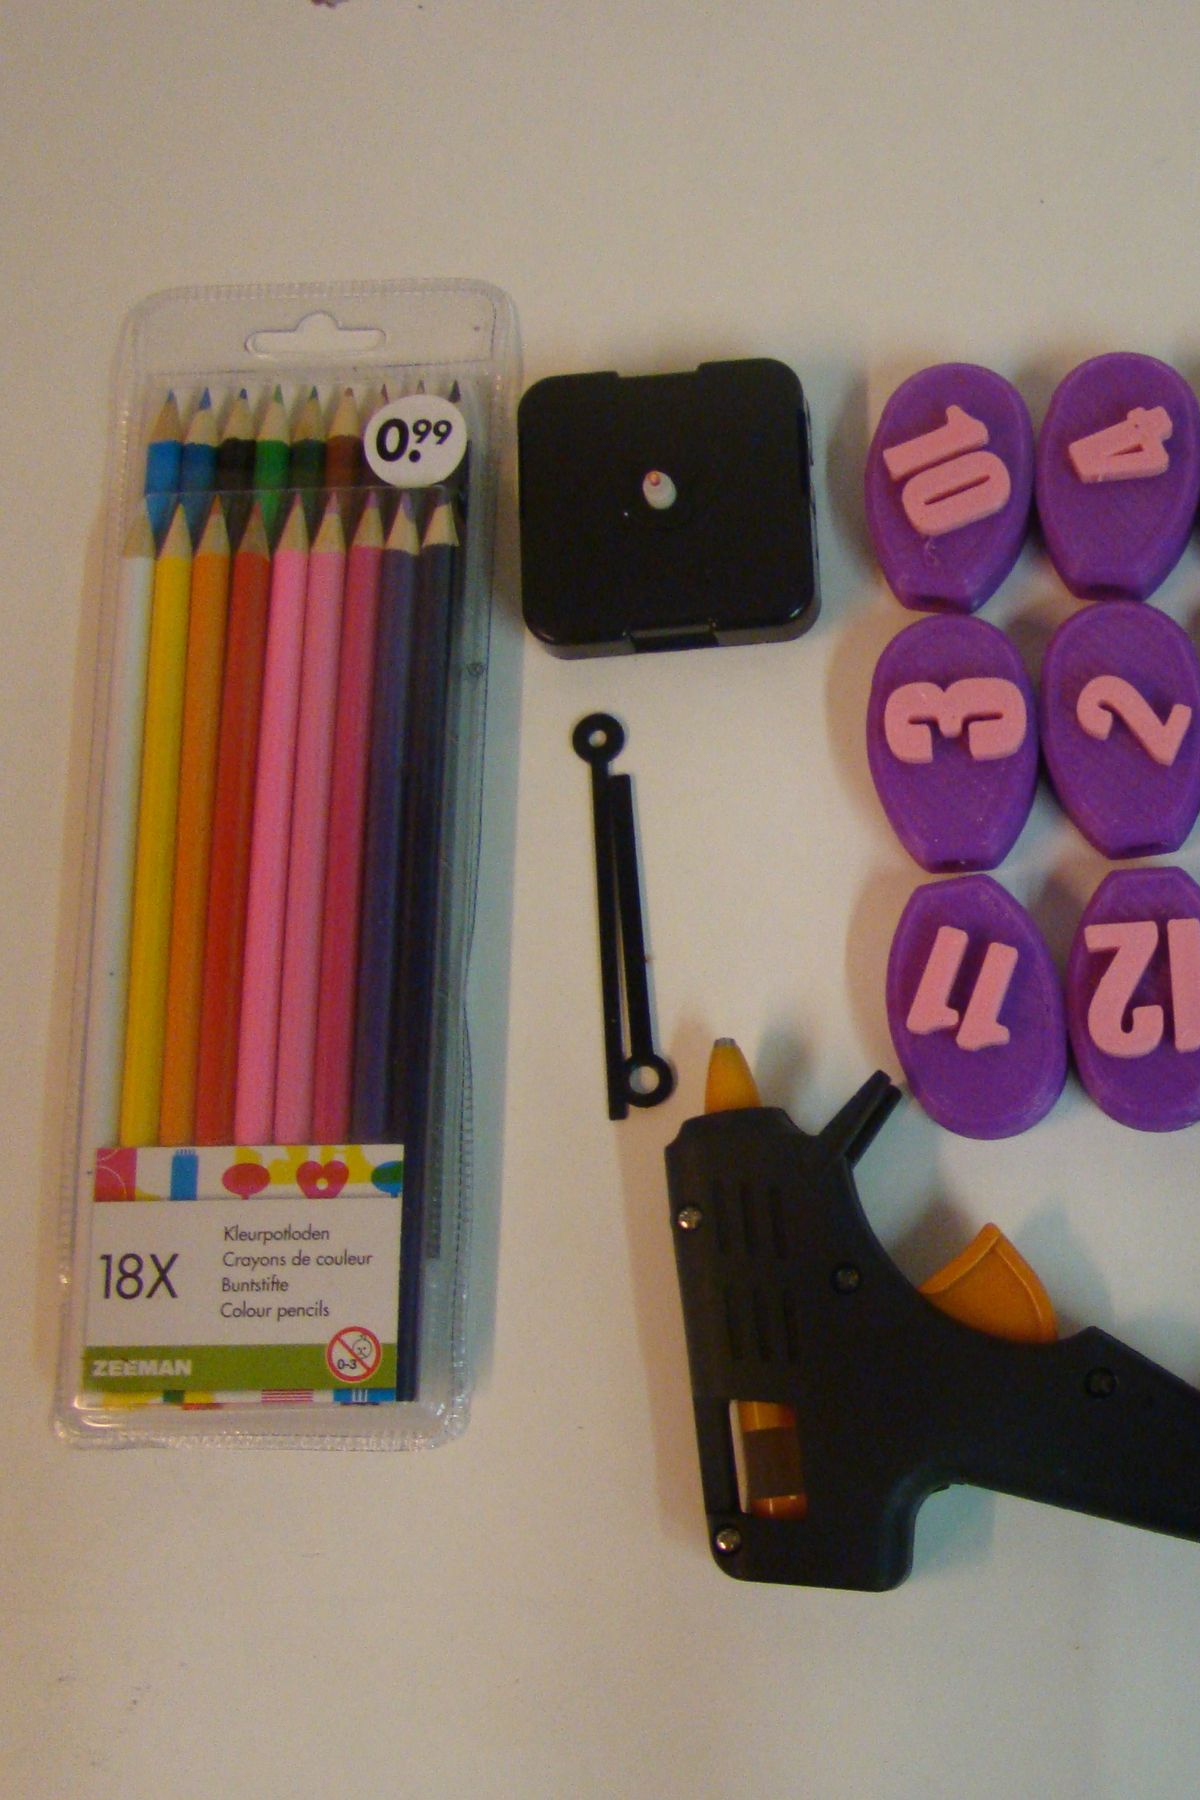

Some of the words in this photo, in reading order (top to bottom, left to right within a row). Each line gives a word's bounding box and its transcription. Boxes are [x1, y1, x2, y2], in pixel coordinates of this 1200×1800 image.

[1067, 405, 1173, 483] 4
[883, 676, 1028, 764] 3
[1075, 674, 1193, 766] 2
[905, 925, 1019, 1052] 11
[223, 1224, 330, 1245] Kleurpotloden
[222, 1251, 287, 1271] Crayons
[291, 1249, 311, 1266] de
[315, 1249, 373, 1266] couleur
[99, 1253, 180, 1300] 18X
[221, 1274, 289, 1292] Buntstifte
[220, 1300, 272, 1318] Colour
[276, 1299, 330, 1321] pencils
[90, 1359, 193, 1377] ZEEMAN
[336, 1358, 358, 1370] 0-3
